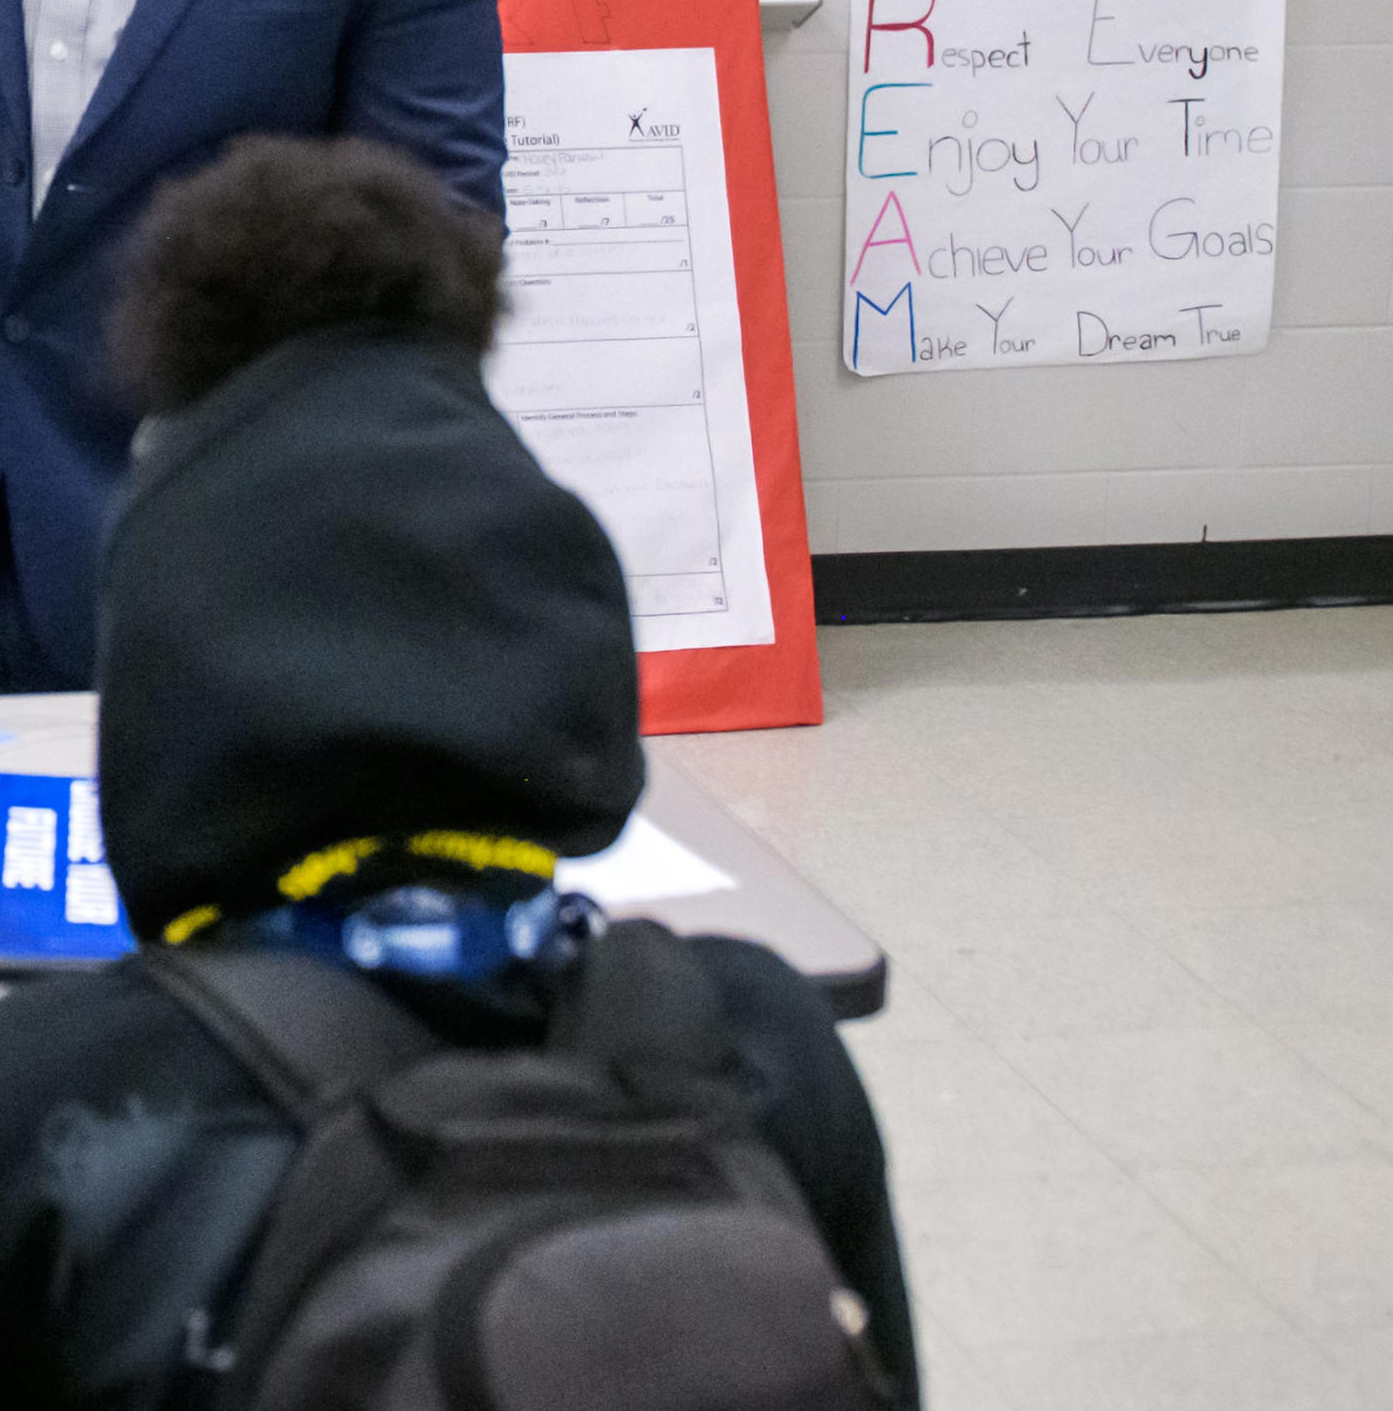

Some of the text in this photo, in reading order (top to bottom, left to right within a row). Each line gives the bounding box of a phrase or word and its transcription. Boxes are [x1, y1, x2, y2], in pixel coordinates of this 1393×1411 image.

[512, 134, 560, 146] Tutorial)
[648, 124, 680, 137] AVID
[858, 86, 1273, 197] Enjoy Your Time
[850, 191, 1274, 286] Achieve Your Goals
[853, 282, 1242, 369] Make Your Dream True
